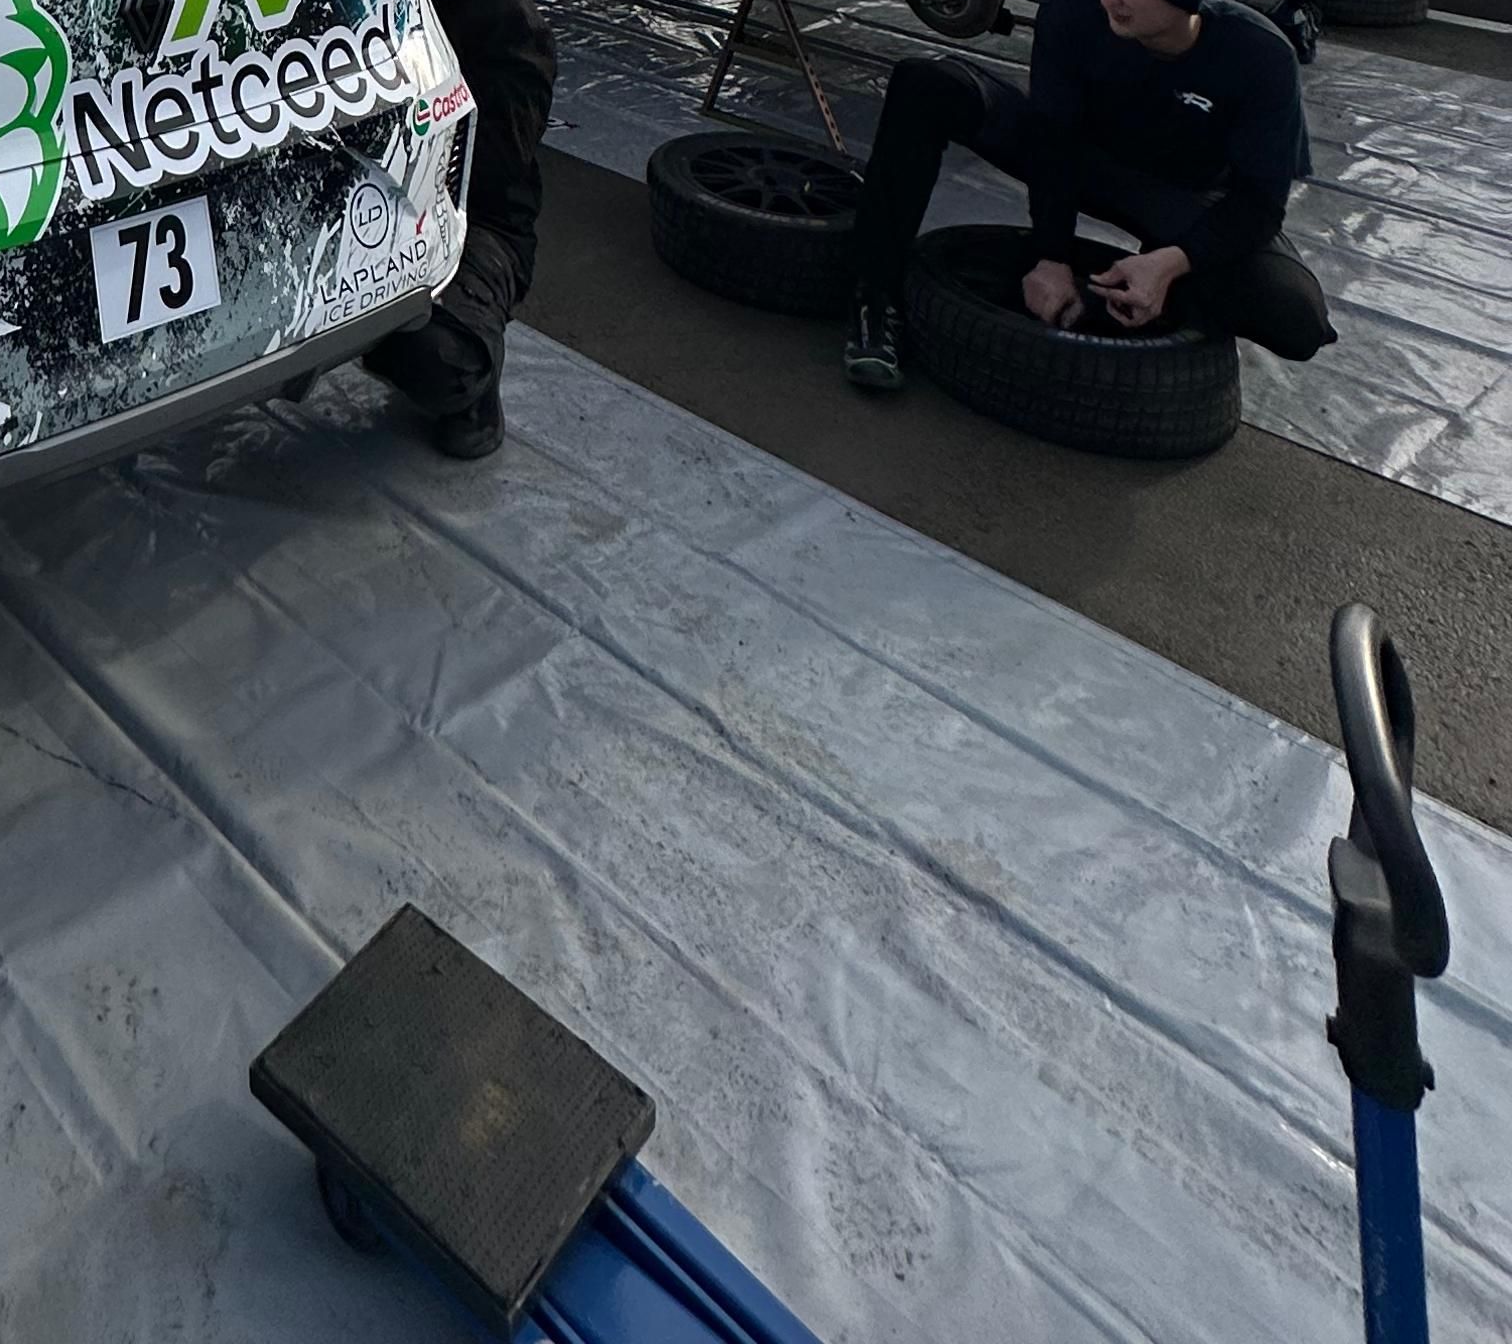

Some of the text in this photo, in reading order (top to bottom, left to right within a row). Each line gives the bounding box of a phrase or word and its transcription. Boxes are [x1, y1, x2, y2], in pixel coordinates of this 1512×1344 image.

[72, 2, 410, 186] Netceed
[118, 214, 194, 325] 73
[319, 239, 427, 305] LAPLAND
[323, 261, 428, 326] ICE DRIVING
